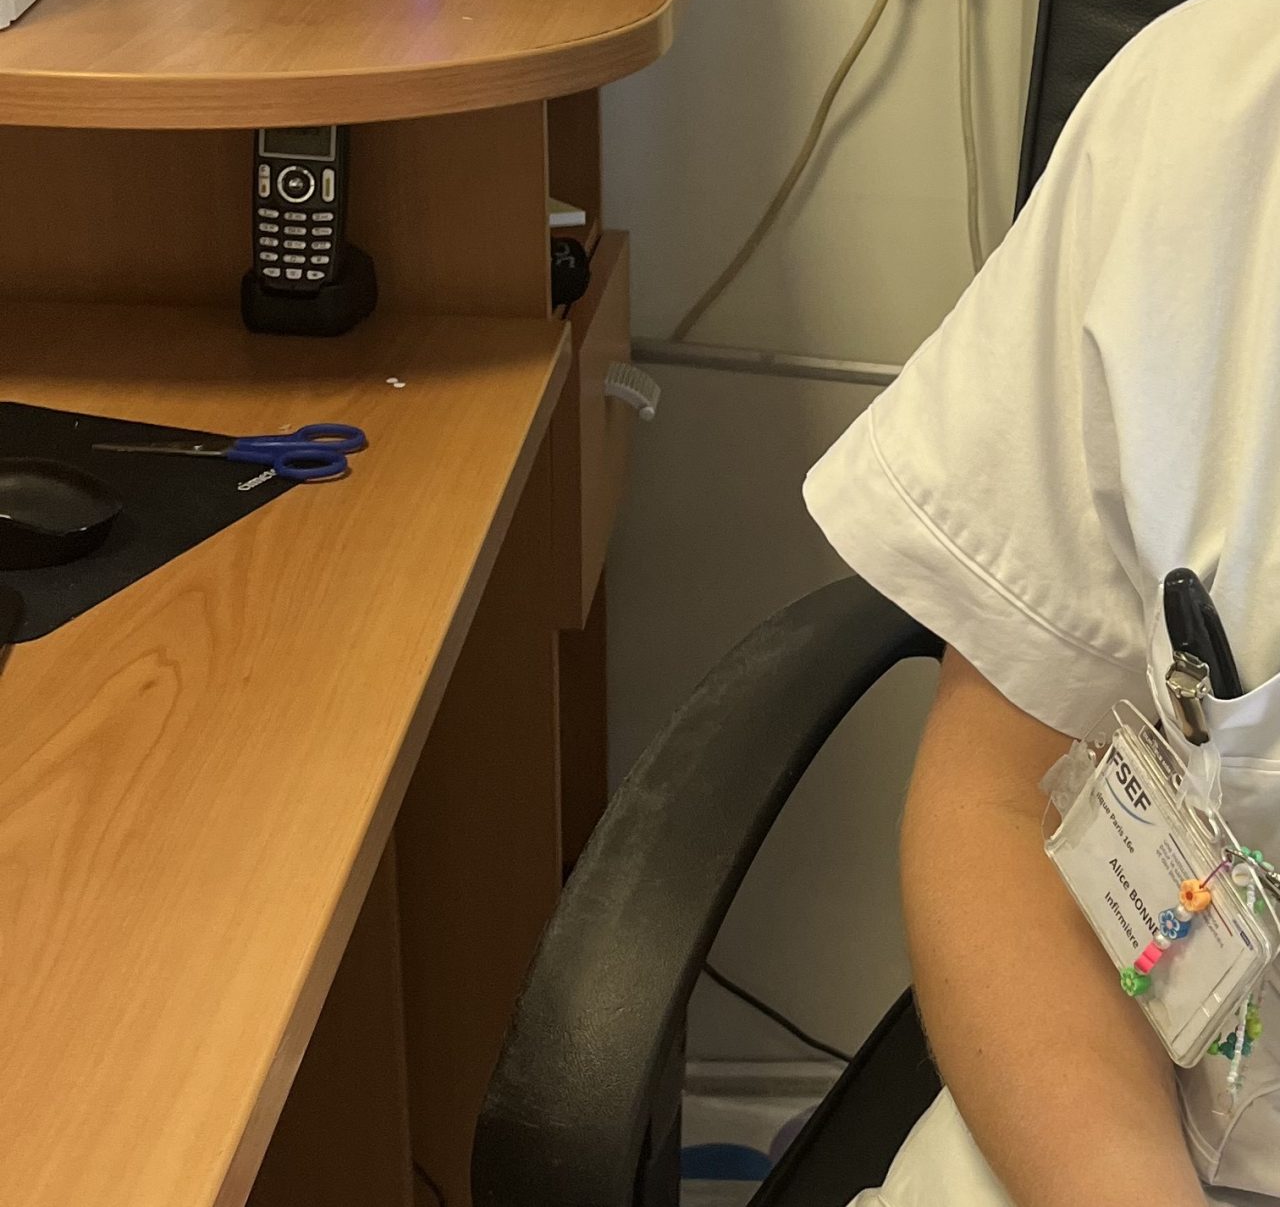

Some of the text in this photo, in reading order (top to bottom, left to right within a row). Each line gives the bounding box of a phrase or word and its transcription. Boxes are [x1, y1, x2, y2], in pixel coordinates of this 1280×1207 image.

[1106, 745, 1152, 812] FSEF
[1110, 813, 1125, 838] Paris
[1123, 836, 1135, 855] 16e
[1108, 857, 1131, 892] Alice
[1104, 890, 1140, 951] Infirmière
